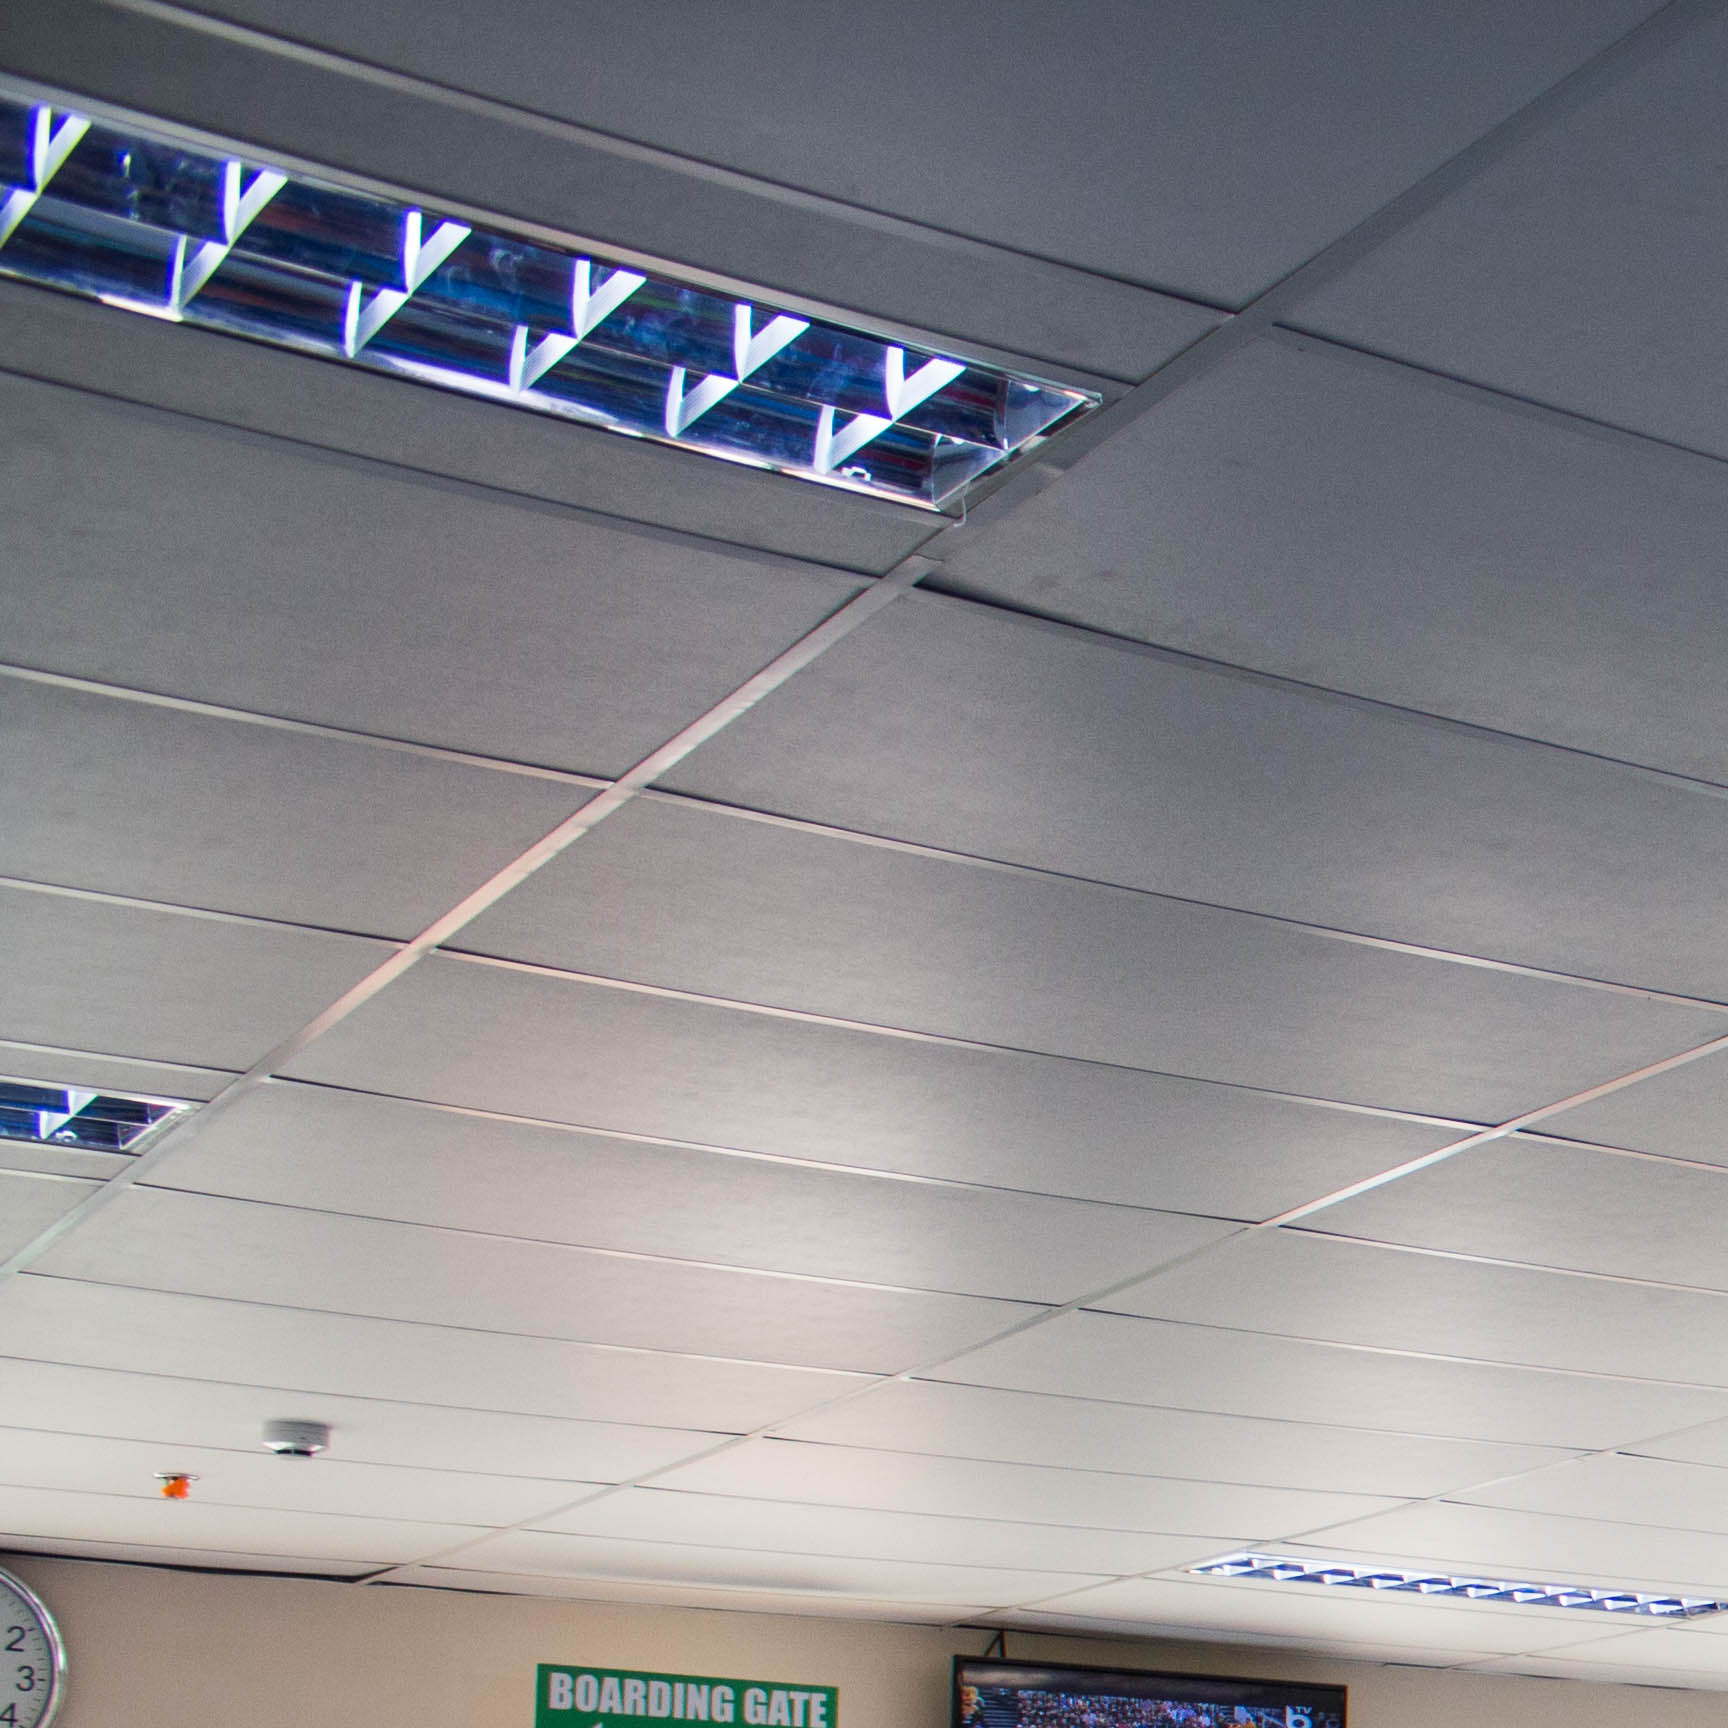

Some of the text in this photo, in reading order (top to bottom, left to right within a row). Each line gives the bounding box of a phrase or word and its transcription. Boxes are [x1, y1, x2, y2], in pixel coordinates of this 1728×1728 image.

[6, 1626, 26, 1652] 2
[15, 1665, 36, 1692] 3
[549, 1671, 735, 1723] BOARDING
[0, 1702, 18, 1728] 4
